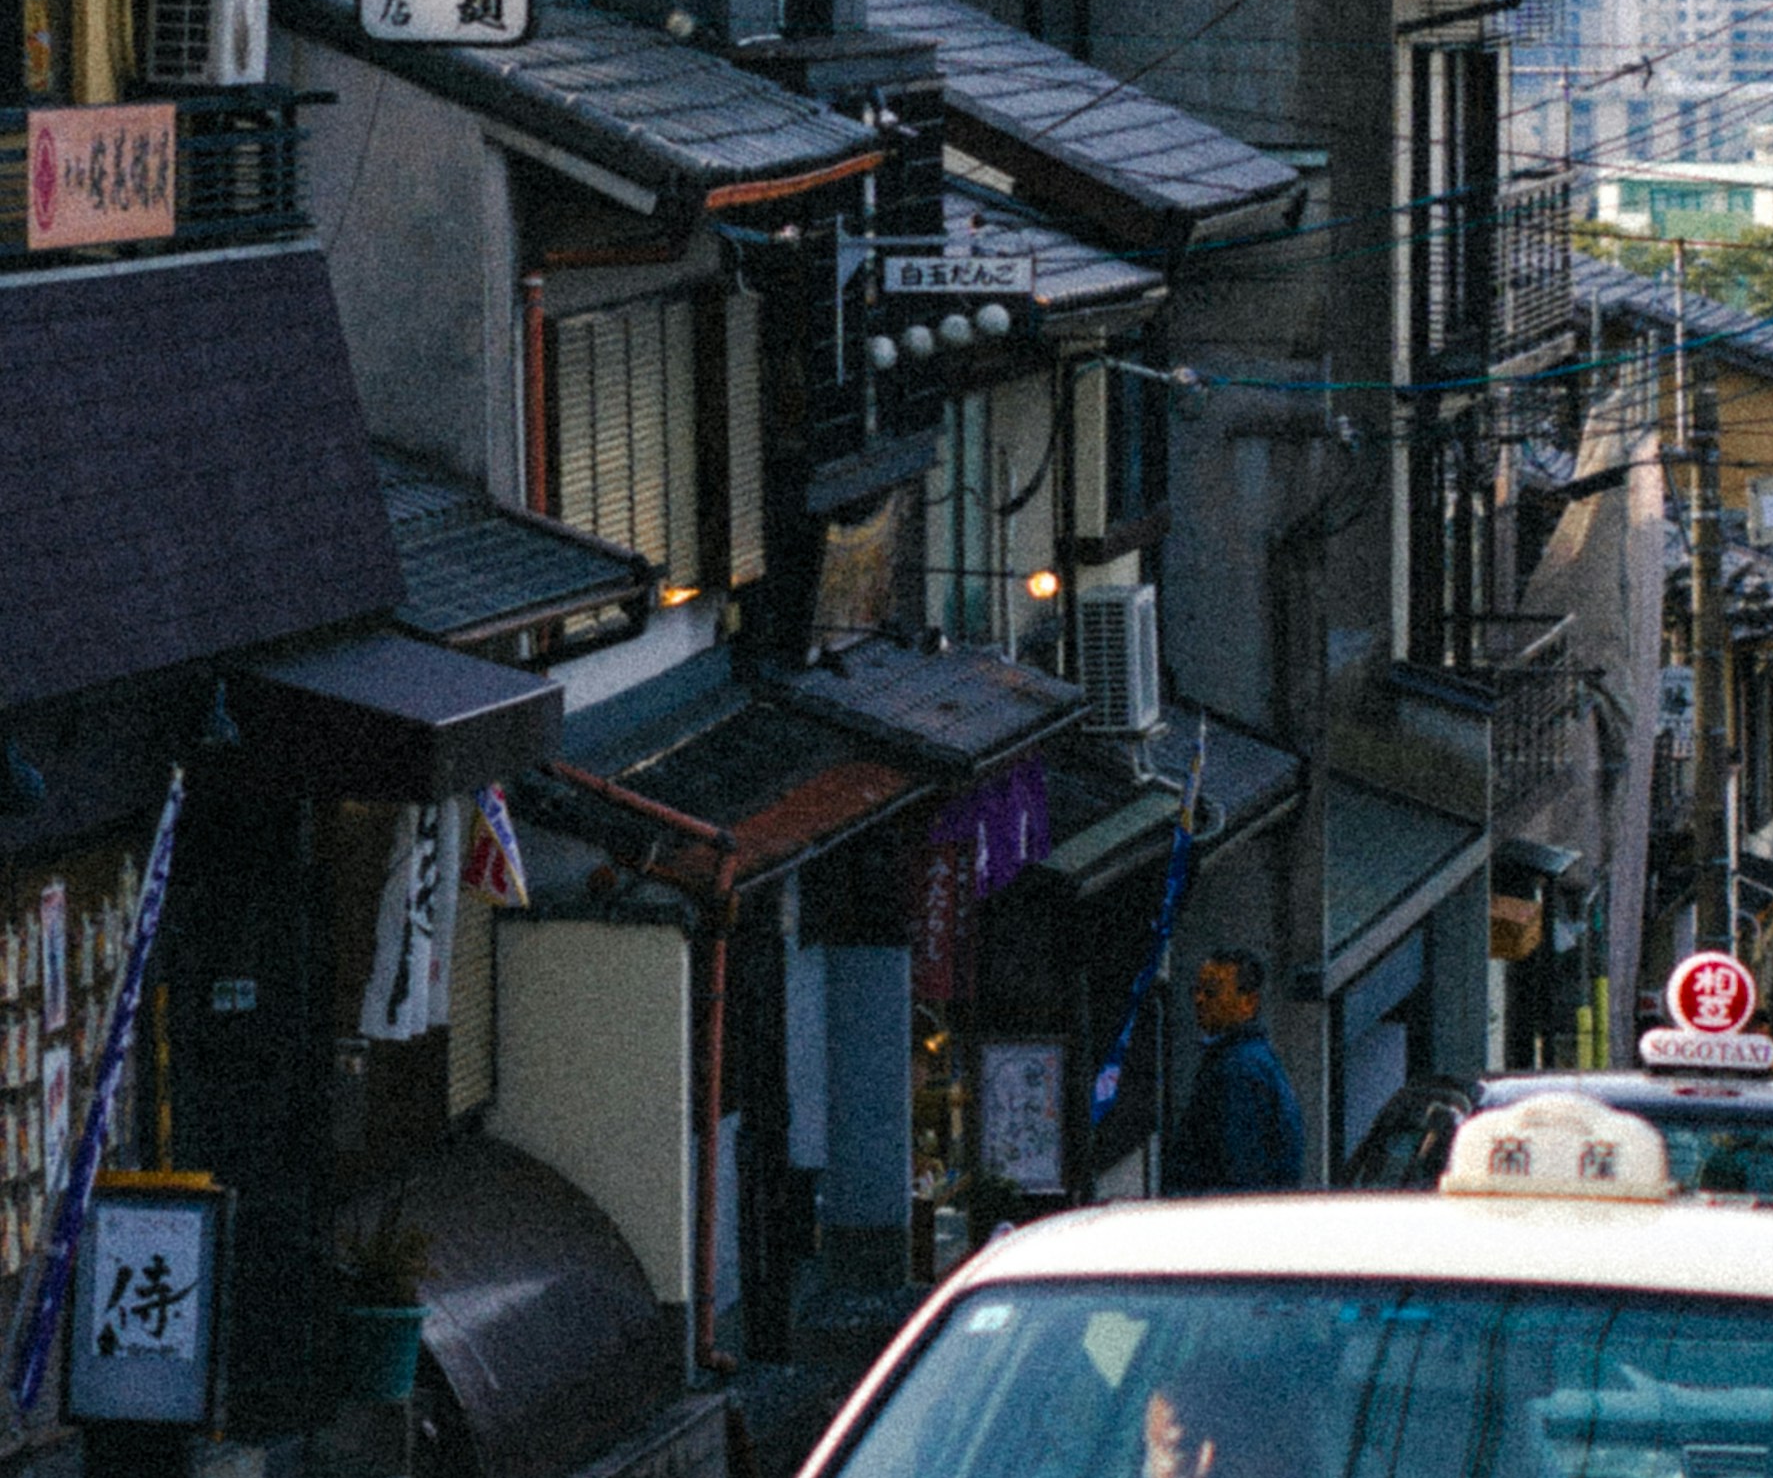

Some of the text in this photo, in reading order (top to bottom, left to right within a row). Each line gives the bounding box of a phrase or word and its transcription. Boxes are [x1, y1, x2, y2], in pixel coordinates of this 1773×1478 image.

[901, 261, 1016, 287] 白玉だんご
[1649, 1039, 1772, 1064] SOGO TAXI
